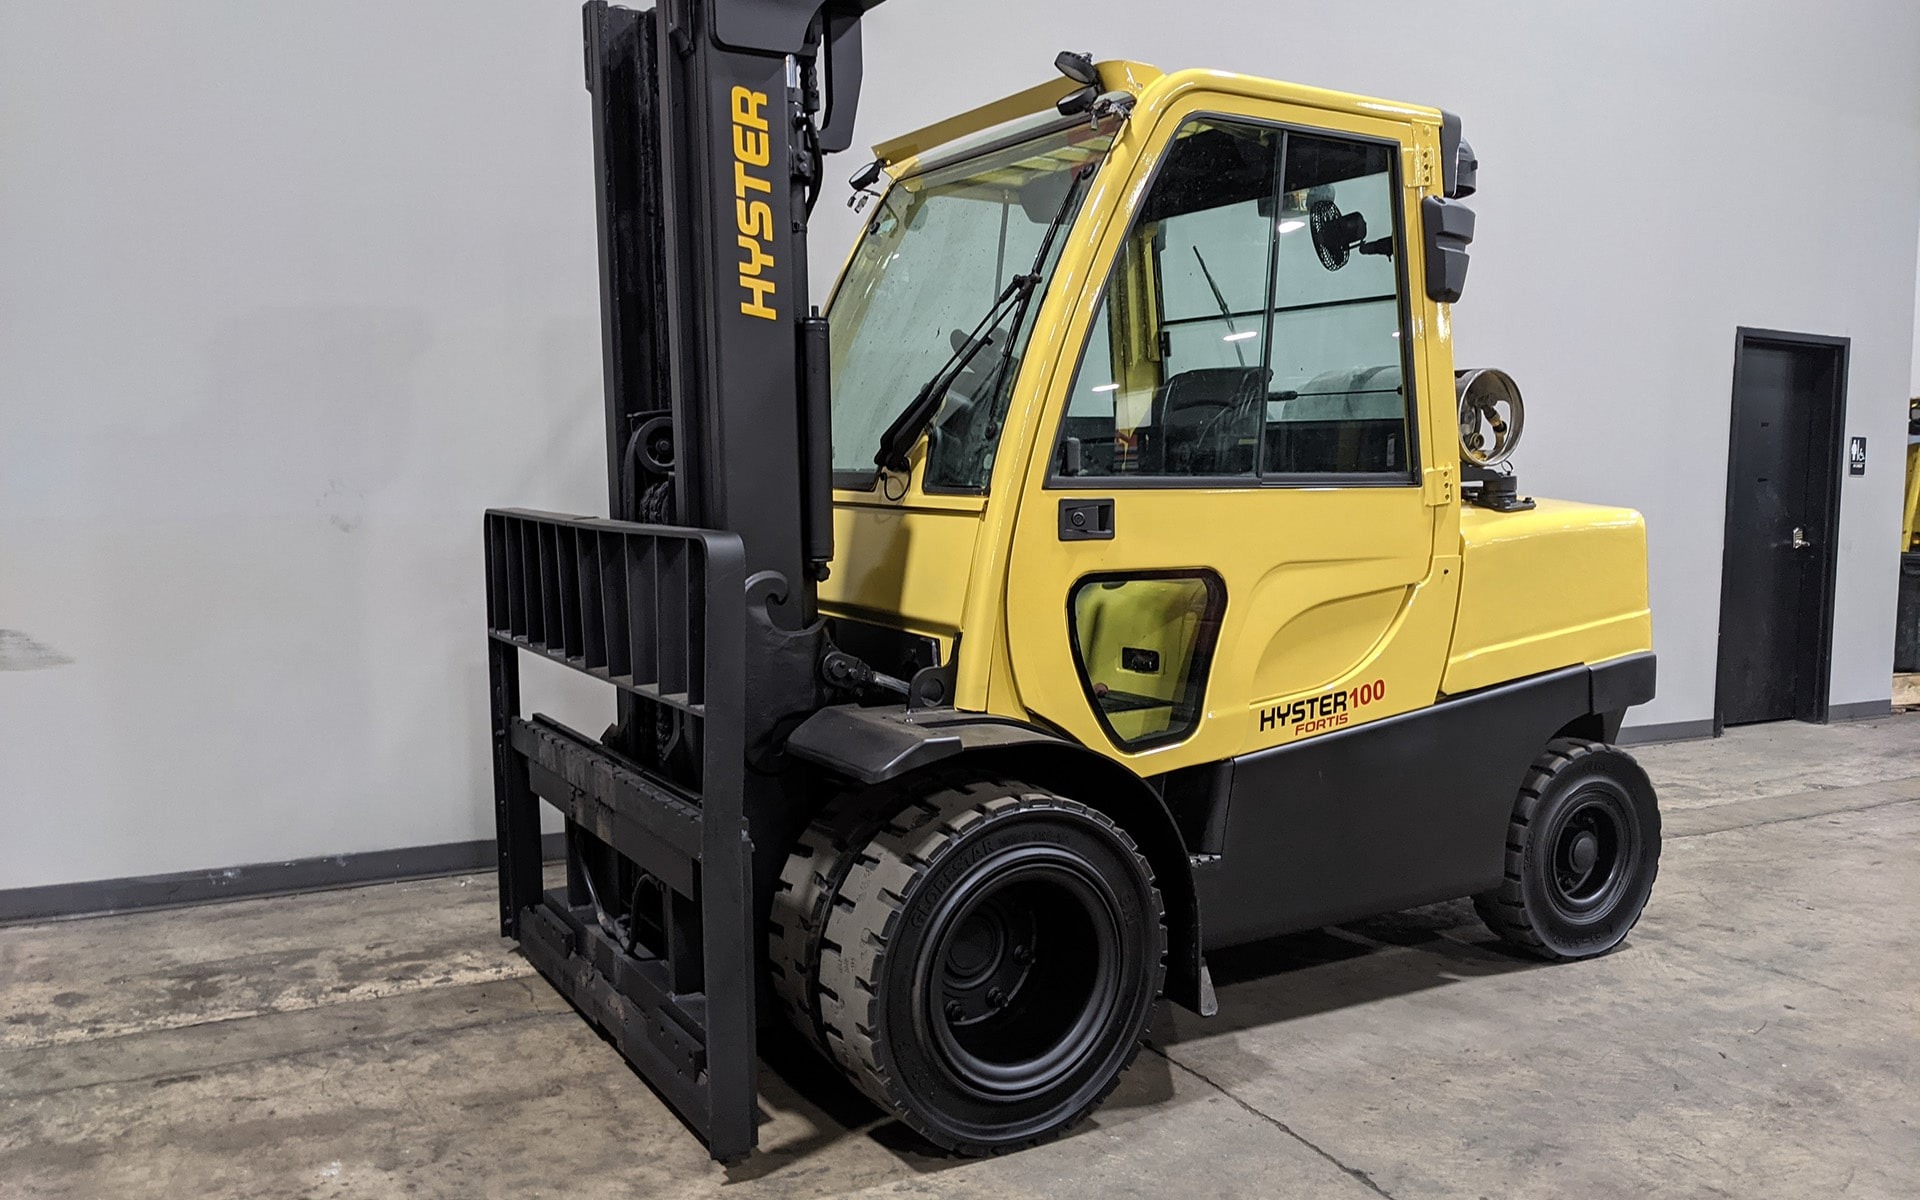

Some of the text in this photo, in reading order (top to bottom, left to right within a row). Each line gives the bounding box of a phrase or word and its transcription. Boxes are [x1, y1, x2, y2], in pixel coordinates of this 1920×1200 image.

[731, 85, 777, 321] HYSTER
[1260, 679, 1385, 732] HYSTER 100
[1295, 713, 1348, 736] FORTIS
